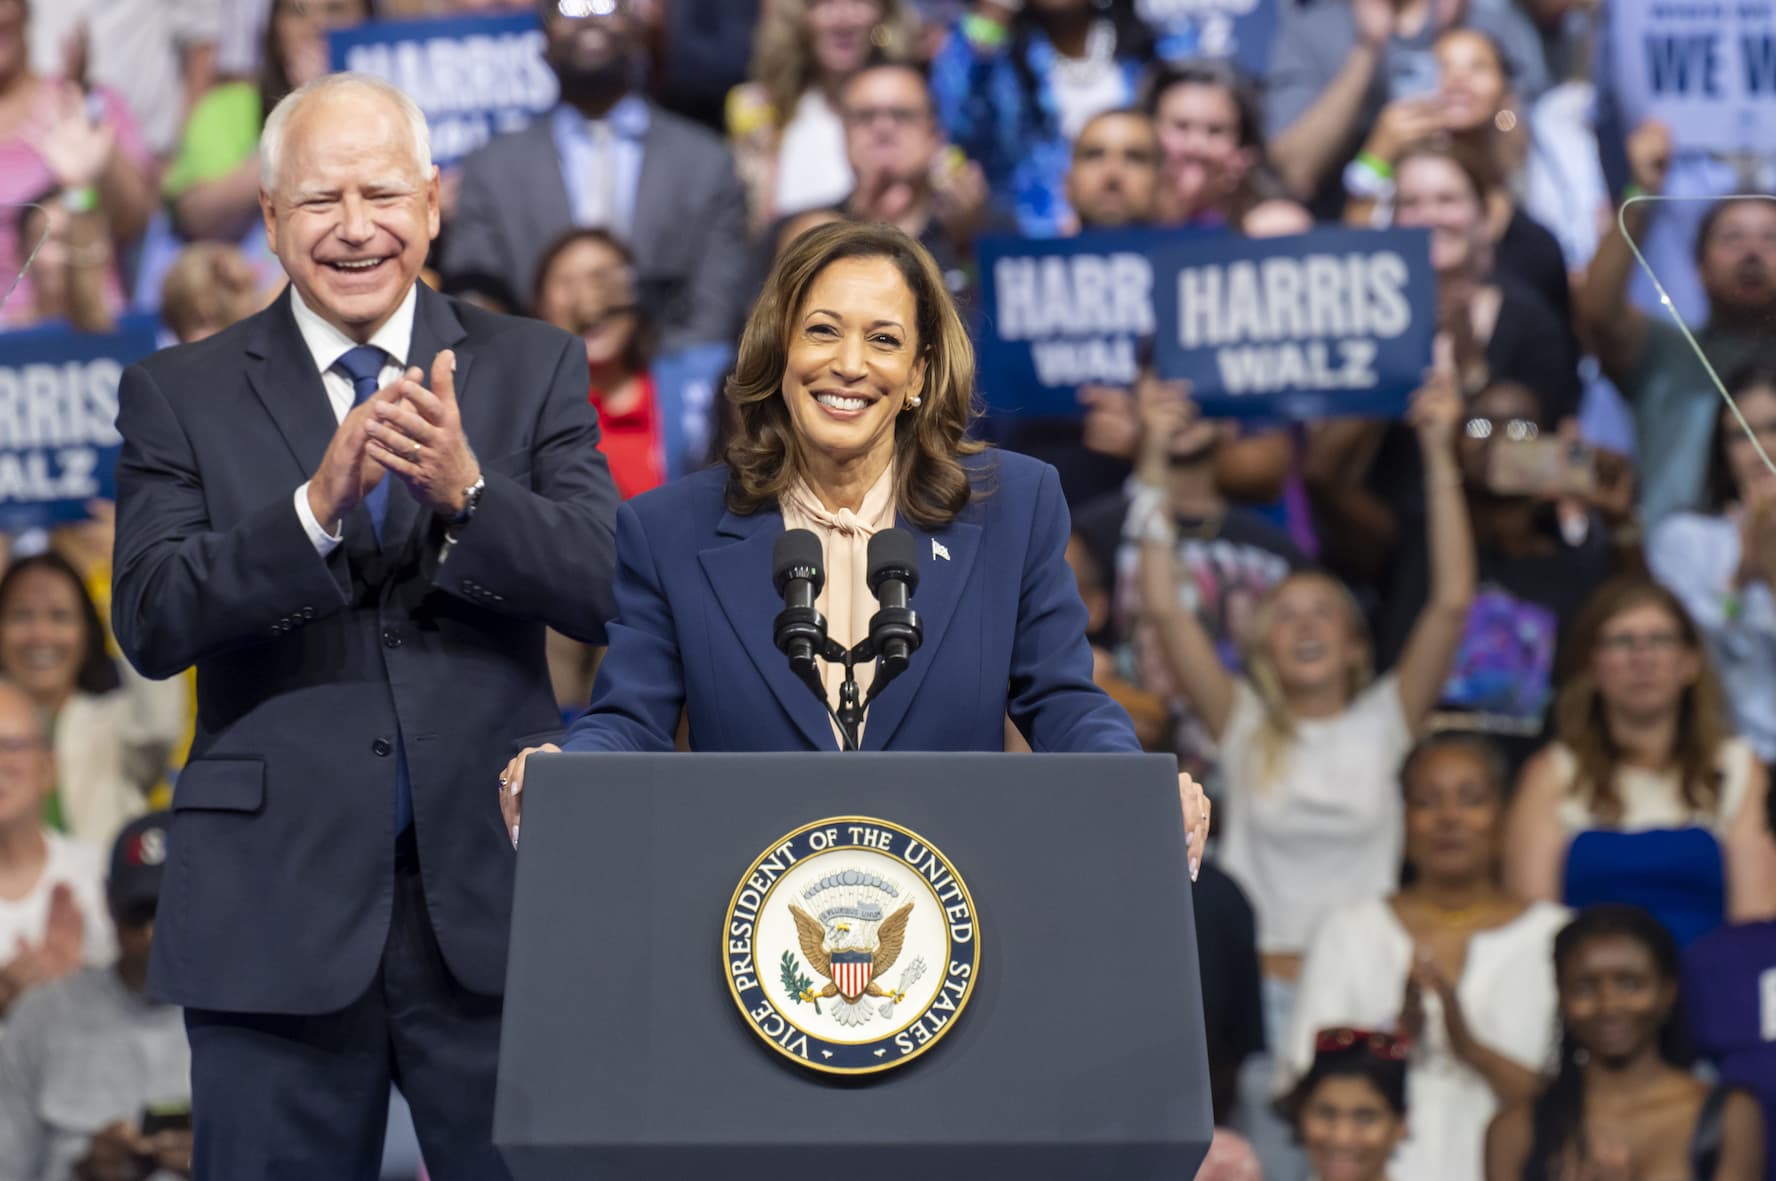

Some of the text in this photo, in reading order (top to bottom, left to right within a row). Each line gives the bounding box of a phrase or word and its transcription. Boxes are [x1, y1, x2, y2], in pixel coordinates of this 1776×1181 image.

[1643, 34, 1721, 98] WE
[1178, 252, 1411, 348] HARRIS
[1217, 340, 1378, 394] WALZ
[729, 826, 974, 1060] VICE PRESIDENT OF THE UNITED STATES
